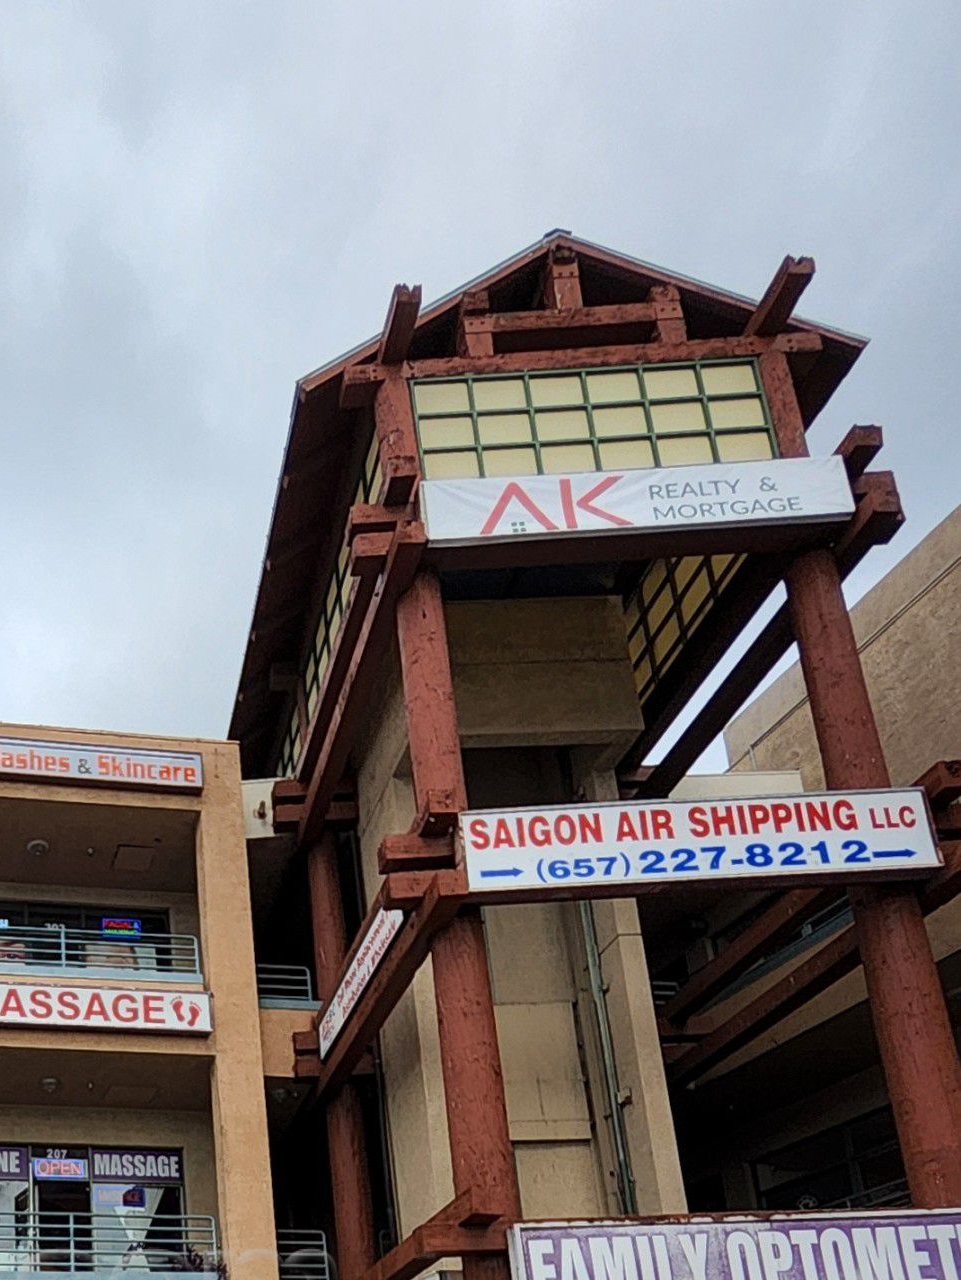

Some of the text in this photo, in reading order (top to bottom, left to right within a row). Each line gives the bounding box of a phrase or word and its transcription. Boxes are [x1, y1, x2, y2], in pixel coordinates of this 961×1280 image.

[649, 476, 779, 501] REALTY &
[480, 475, 634, 536] AK
[653, 496, 804, 521] MORTGAGE
[78, 758, 92, 775] &
[98, 754, 196, 783] Skincare
[469, 799, 917, 850] SAIGON AIR SHIPPING LLC
[537, 839, 874, 883] (657) 227-8212
[46, 1148, 67, 1159] 207
[94, 1153, 180, 1178] MASSAGE
[37, 1161, 82, 1175] OPEN
